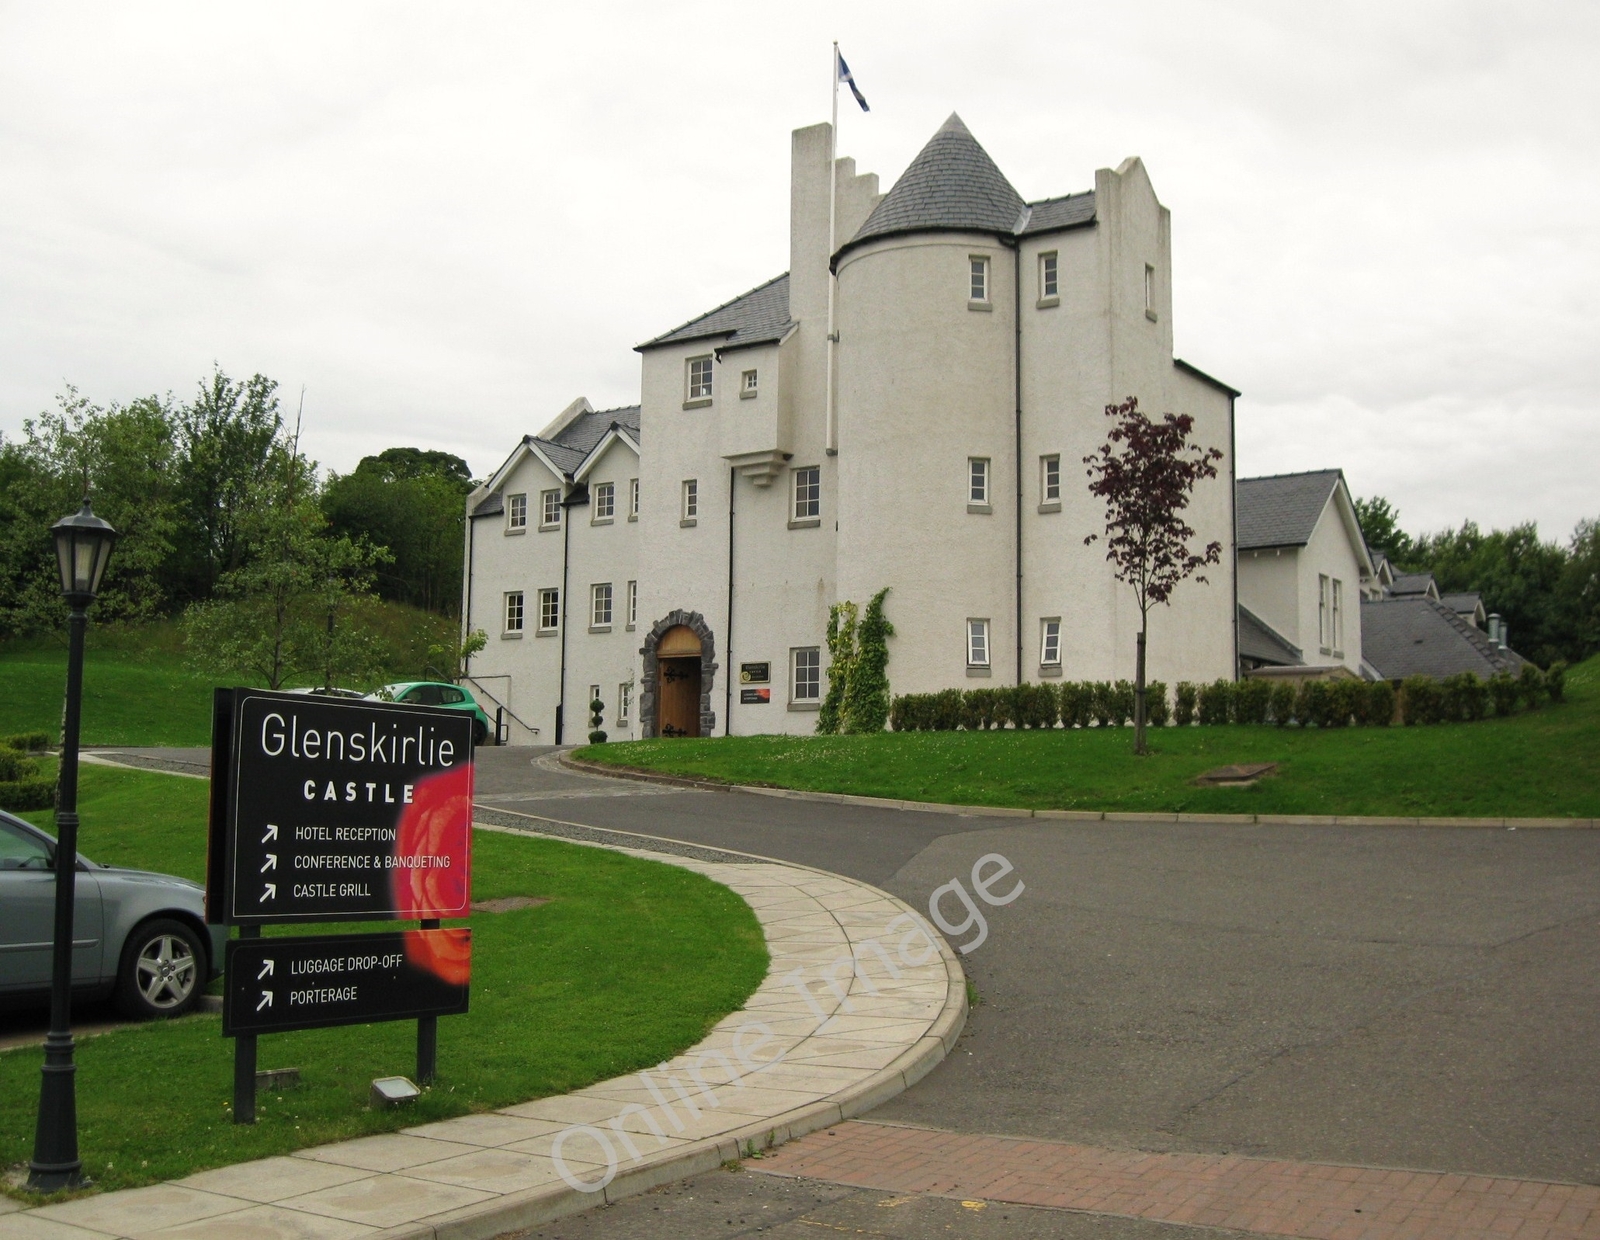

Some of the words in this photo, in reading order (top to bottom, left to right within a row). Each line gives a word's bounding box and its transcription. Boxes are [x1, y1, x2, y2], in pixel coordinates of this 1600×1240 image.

[261, 713, 454, 767] Glenskirlie
[303, 780, 414, 804] CASTLE
[295, 827, 332, 841] HOTEL
[335, 827, 396, 841] RECEPTION
[294, 855, 371, 869] CONFERENCE
[373, 856, 381, 868] &
[384, 856, 450, 868] BANQUETING
[293, 884, 337, 897] CASTLE
[339, 883, 371, 896] GRILL
[291, 957, 345, 975] LUGGAGE
[347, 954, 403, 971] DROP-OFF
[290, 986, 357, 1005] PORTERAGE
